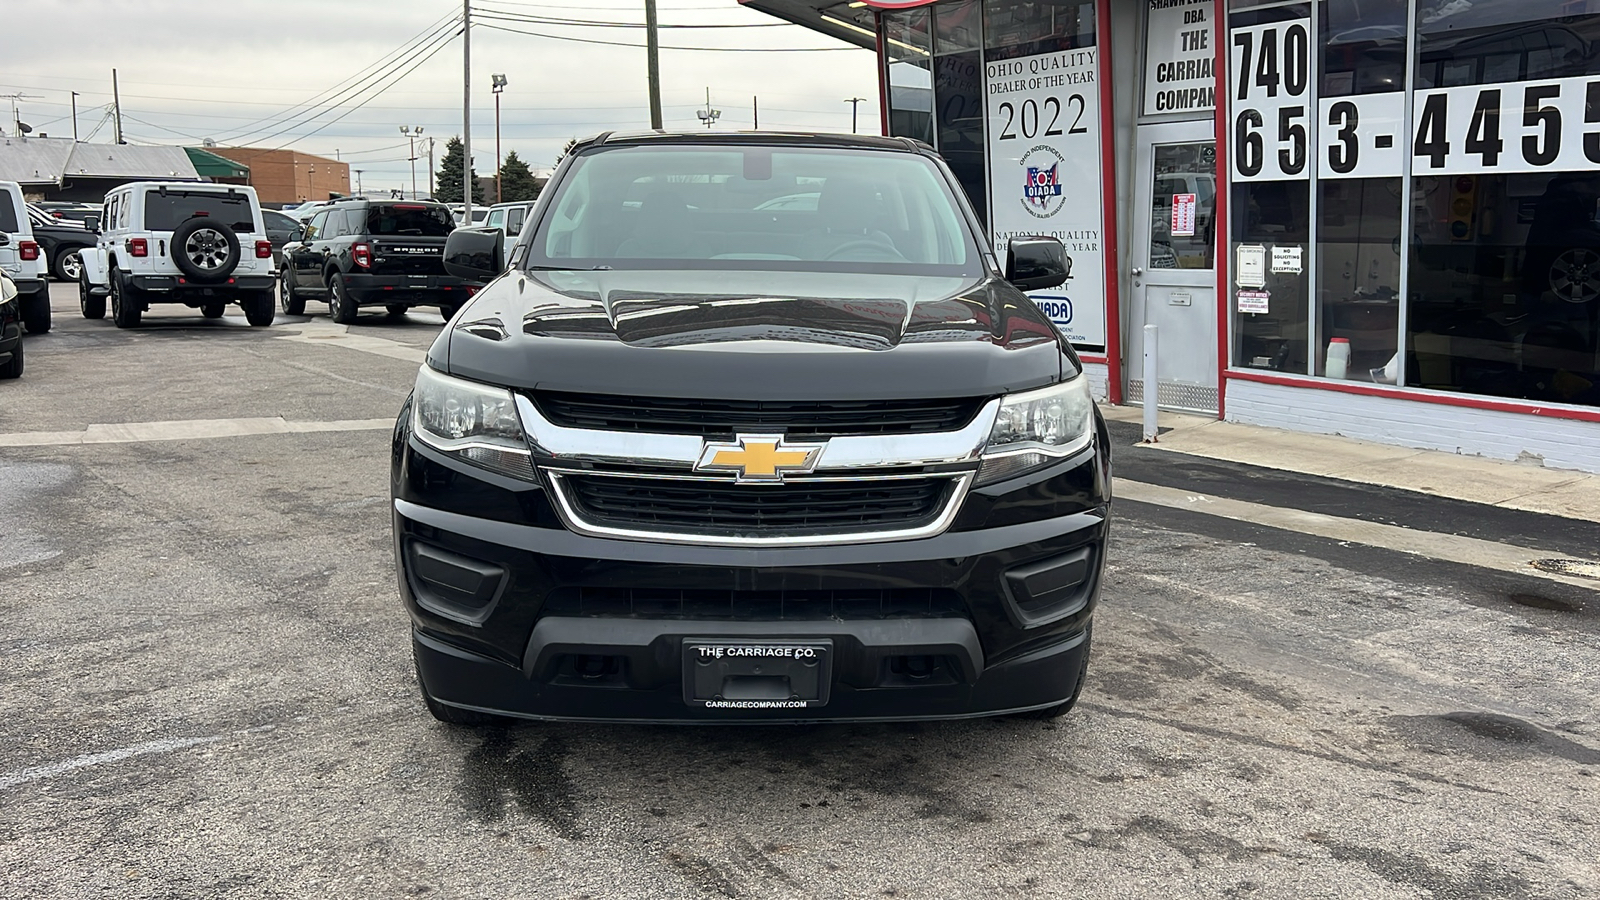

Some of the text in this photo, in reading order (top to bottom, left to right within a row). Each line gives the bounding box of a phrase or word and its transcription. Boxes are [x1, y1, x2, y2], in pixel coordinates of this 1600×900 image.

[1184, 9, 1206, 24] DBA.
[1181, 29, 1208, 52] THE
[988, 50, 1096, 79] OHIO QUALITY
[1156, 57, 1216, 84] CARRIA
[1234, 24, 1308, 101] 740
[989, 70, 1095, 95] DEALER OF THE YEAR
[1155, 86, 1216, 112] COMPAN
[998, 93, 1088, 141] 2022
[1019, 144, 1066, 166] OHIO INDEPENDENT
[1028, 185, 1056, 197] OIADA
[1051, 230, 1098, 240] QUALITY
[1071, 243, 1098, 252] YEAR
[698, 647, 817, 659] THE CARRIAGE CO.
[705, 701, 807, 709] CARRIAGECOMPANY.COM
